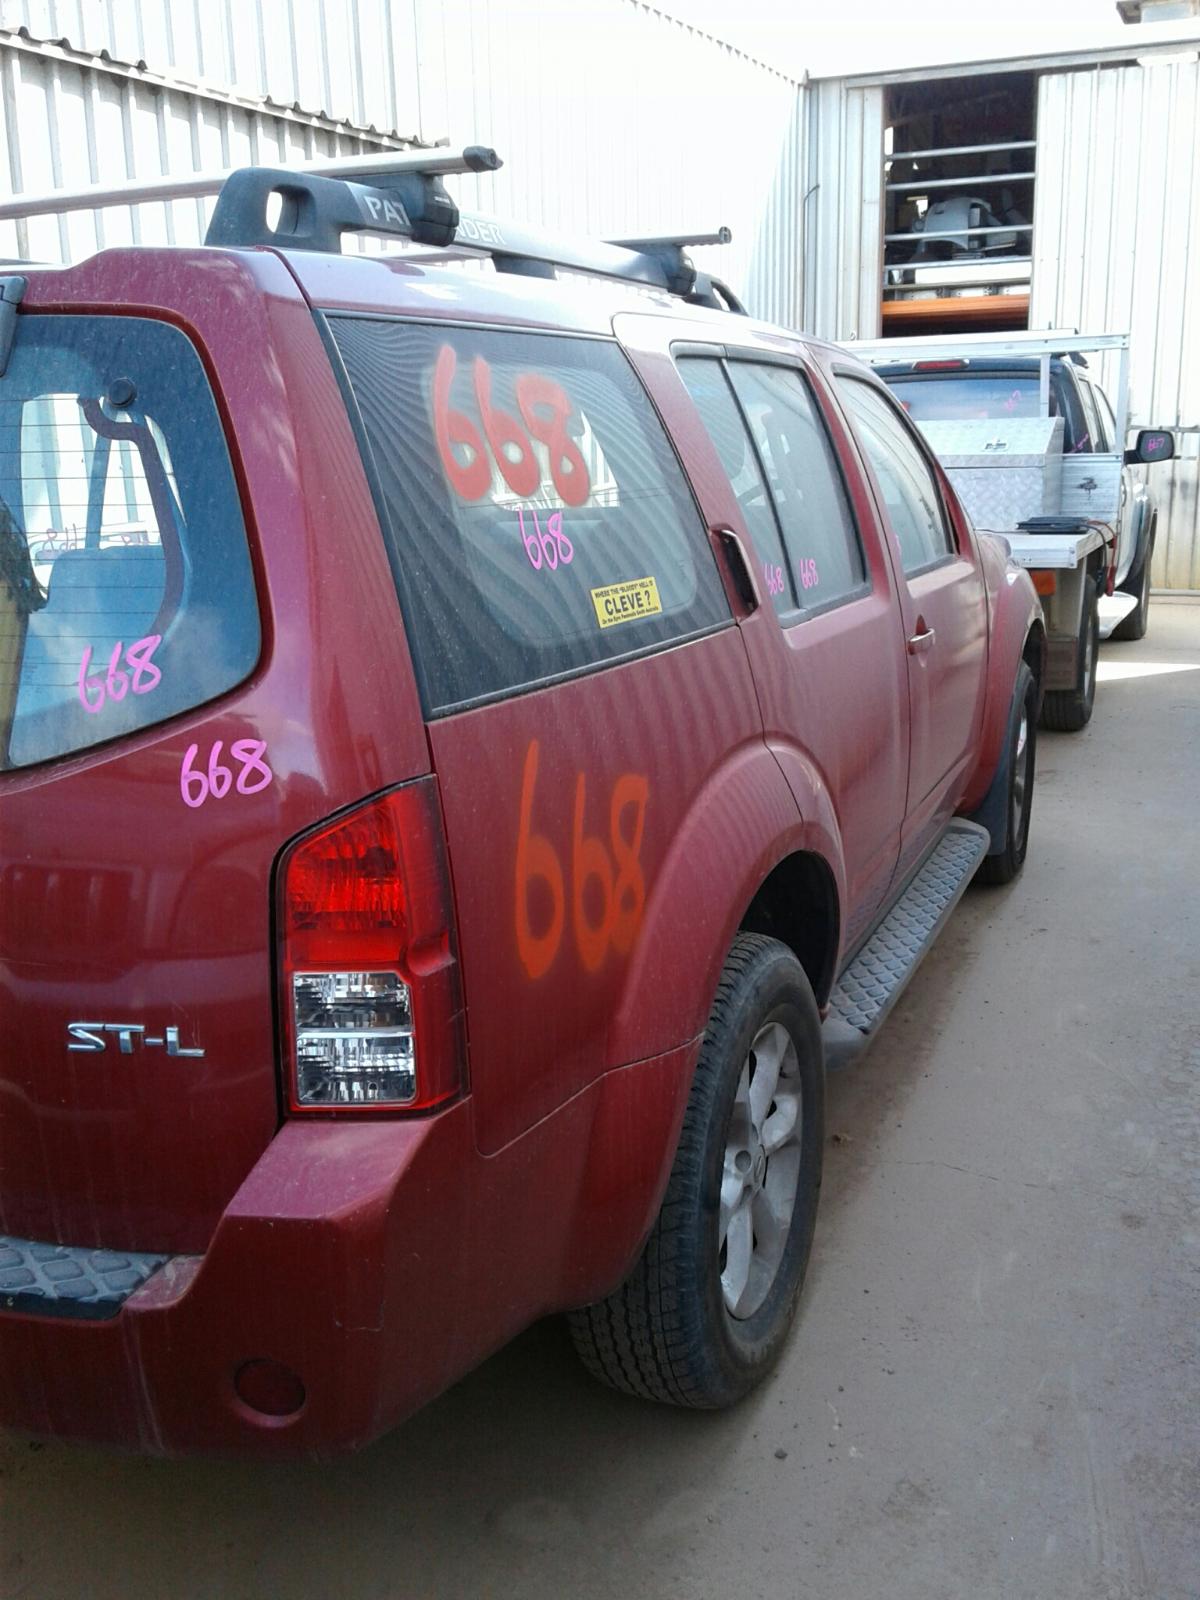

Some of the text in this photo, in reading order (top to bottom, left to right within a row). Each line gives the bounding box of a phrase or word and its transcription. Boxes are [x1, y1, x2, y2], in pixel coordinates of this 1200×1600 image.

[433, 344, 591, 507] 668
[516, 506, 574, 570] 668
[764, 563, 785, 596] 668
[800, 558, 819, 590] 668
[78, 635, 161, 713] 668
[180, 738, 273, 808] 668
[515, 737, 650, 980] 668
[67, 1023, 205, 1057] ST-L
